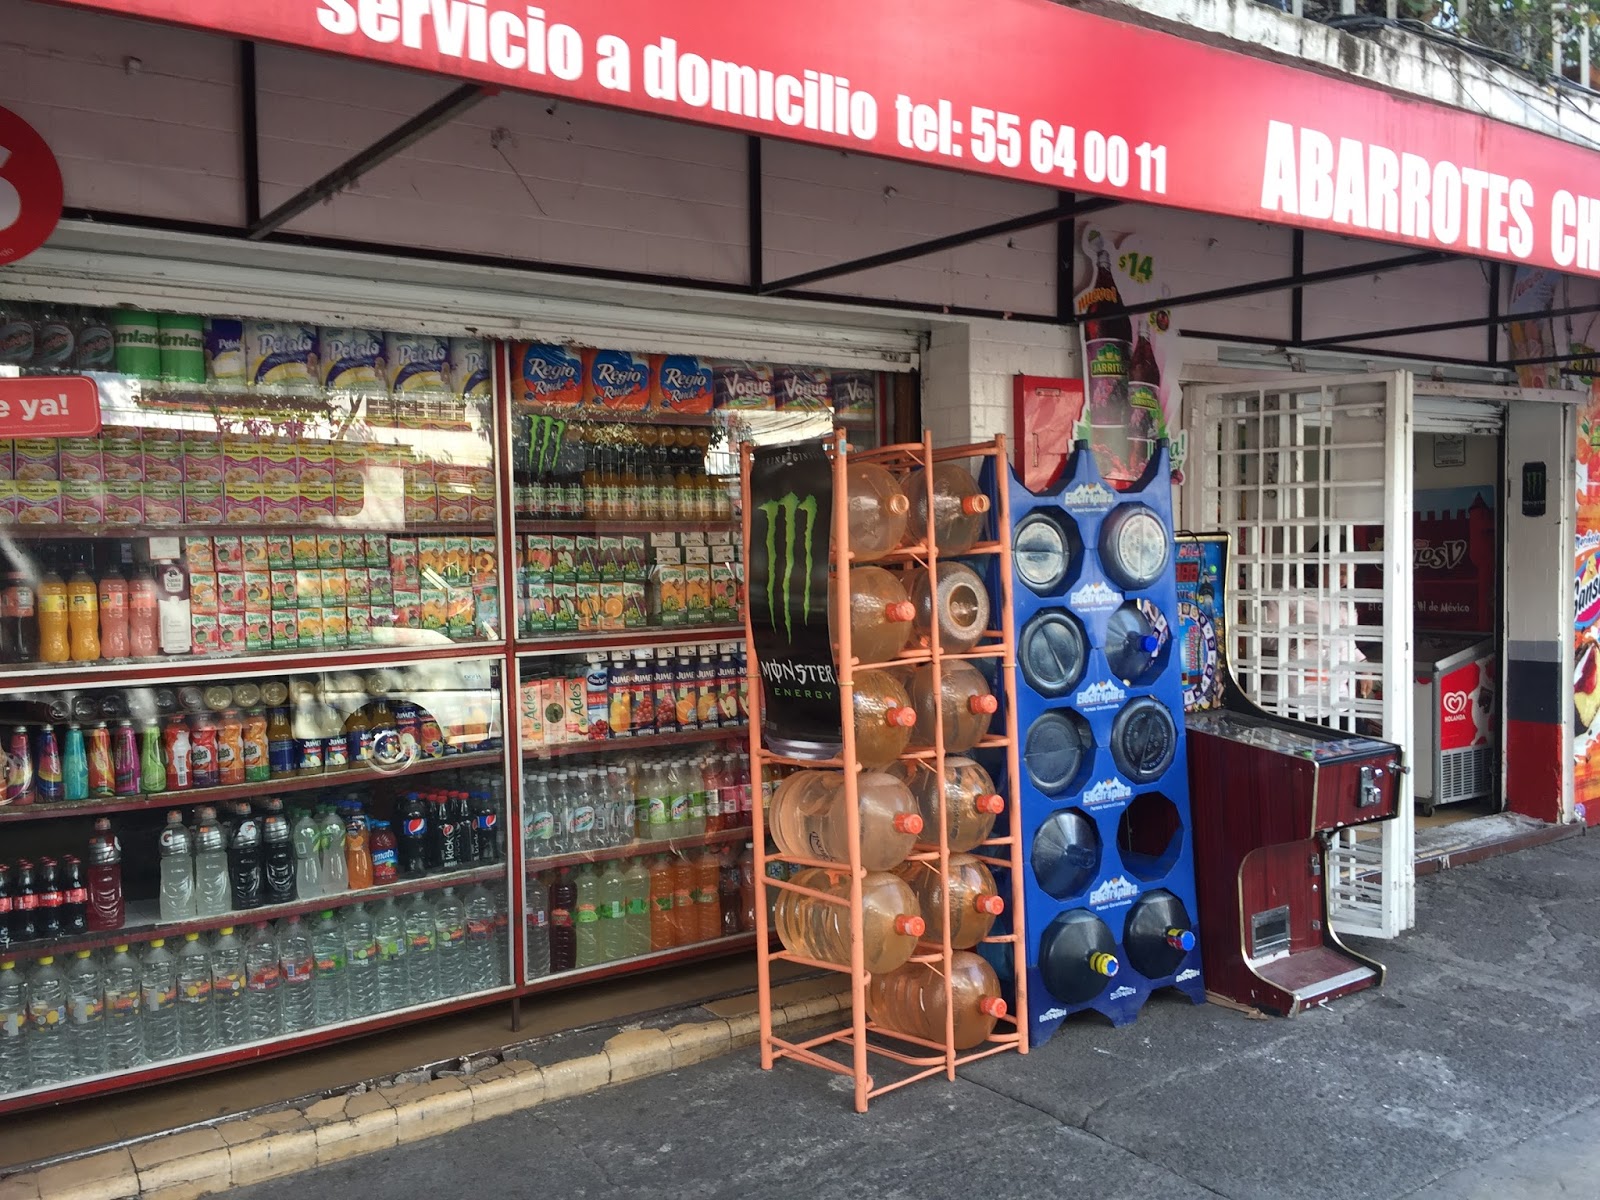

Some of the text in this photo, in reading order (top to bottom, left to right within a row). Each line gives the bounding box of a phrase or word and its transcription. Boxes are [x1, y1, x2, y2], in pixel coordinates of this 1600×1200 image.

[316, 0, 1167, 194] servicio a domicilio tel: 55 64 00 11
[1260, 119, 1600, 275] ABARROTES CH
[1119, 252, 1153, 281] $14
[528, 358, 576, 380] Regio
[597, 363, 641, 385] Regio
[665, 368, 707, 387] Regio
[723, 373, 771, 398] Vogue
[784, 375, 827, 398] Vogue
[19, 394, 69, 421] ya!
[761, 658, 837, 686] MONSTER
[569, 682, 584, 717] AdeS
[774, 687, 833, 700] ENERGY
[1444, 714, 1466, 723] HOLANDA
